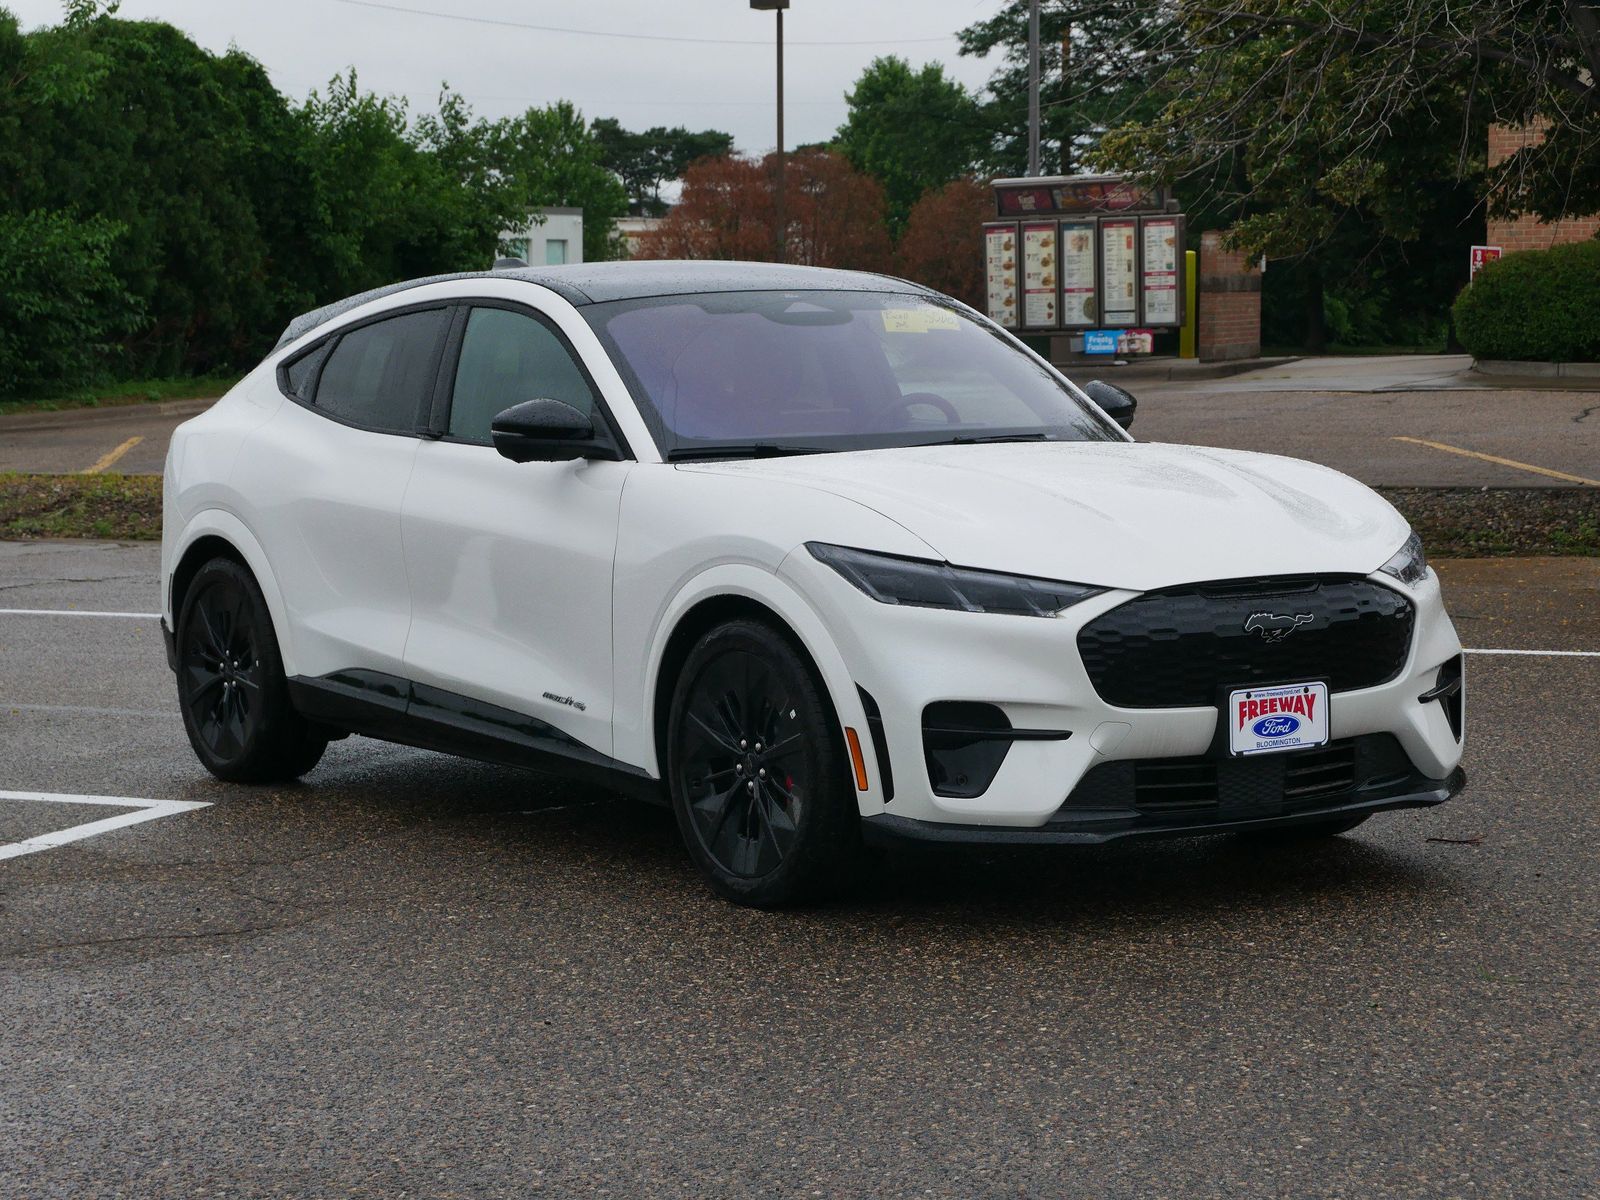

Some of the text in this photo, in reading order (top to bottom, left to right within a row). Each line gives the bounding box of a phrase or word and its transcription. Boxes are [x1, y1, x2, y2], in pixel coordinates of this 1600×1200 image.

[1087, 335, 1113, 345] Frosty
[1238, 693, 1316, 732] FREEWAY
[1261, 718, 1291, 734] Ford
[1256, 737, 1301, 748] BLOOMINGTON
